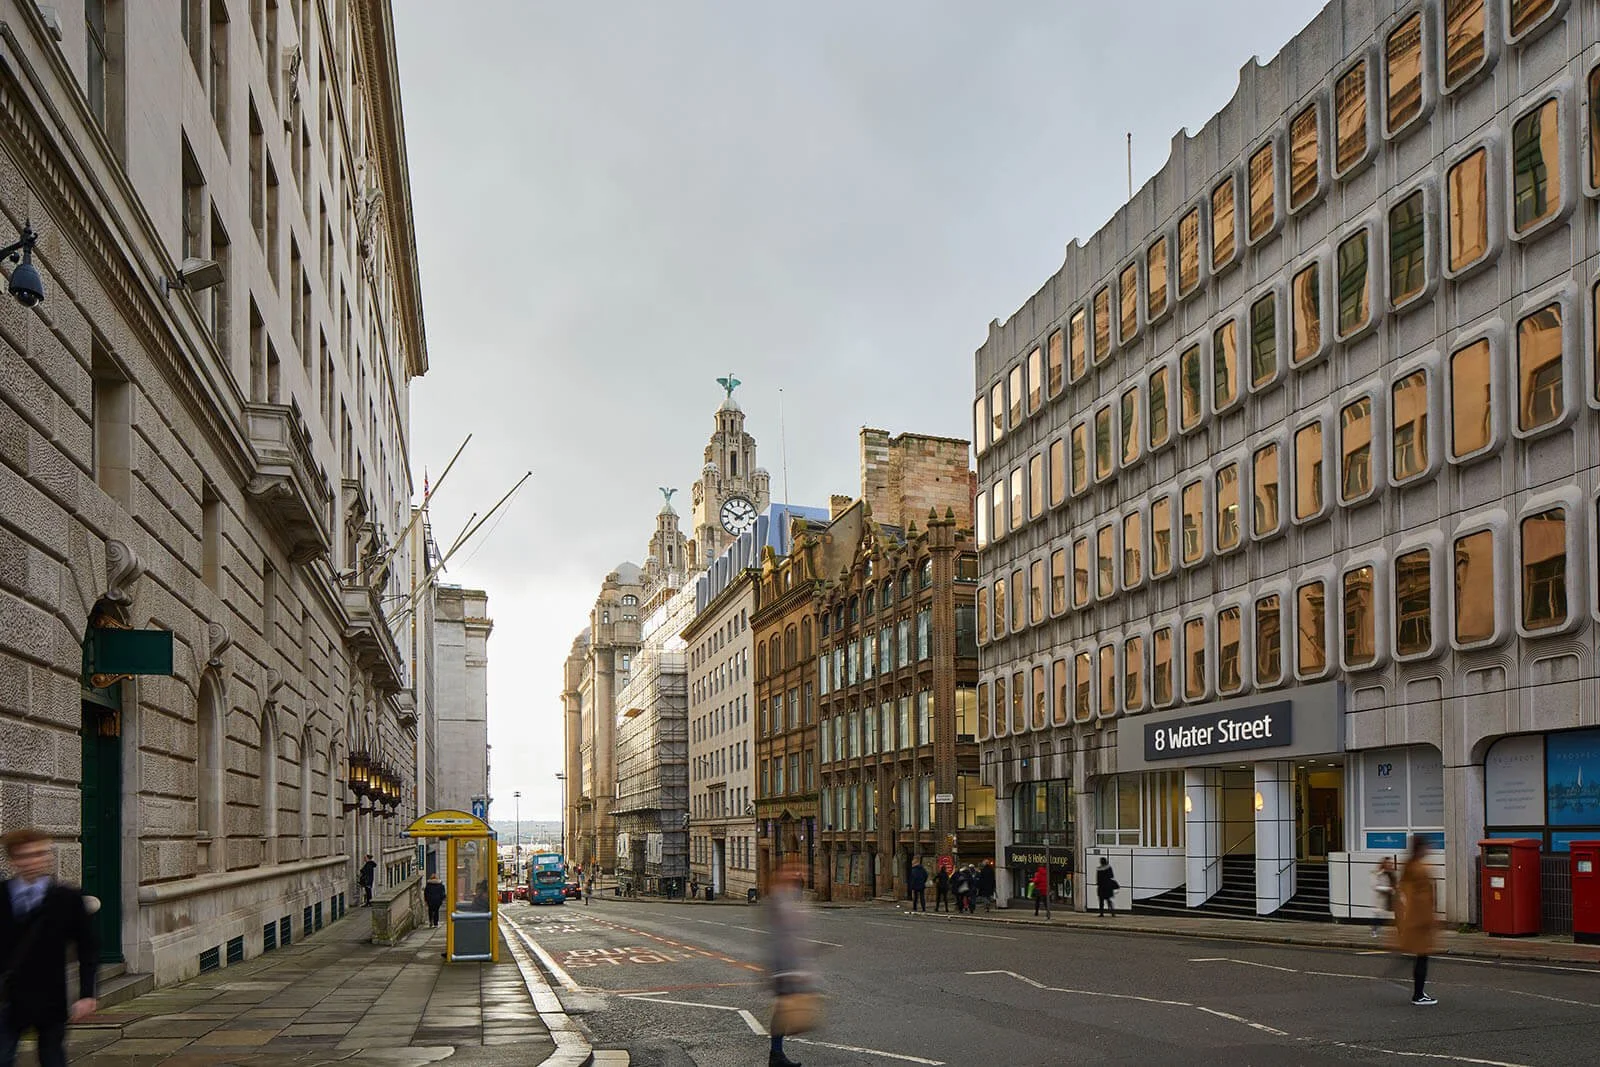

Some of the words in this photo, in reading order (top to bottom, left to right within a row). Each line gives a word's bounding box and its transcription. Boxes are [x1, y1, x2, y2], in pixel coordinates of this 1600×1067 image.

[1154, 729, 1165, 751] 8
[1168, 726, 1214, 749] Water
[1217, 715, 1272, 743] Street
